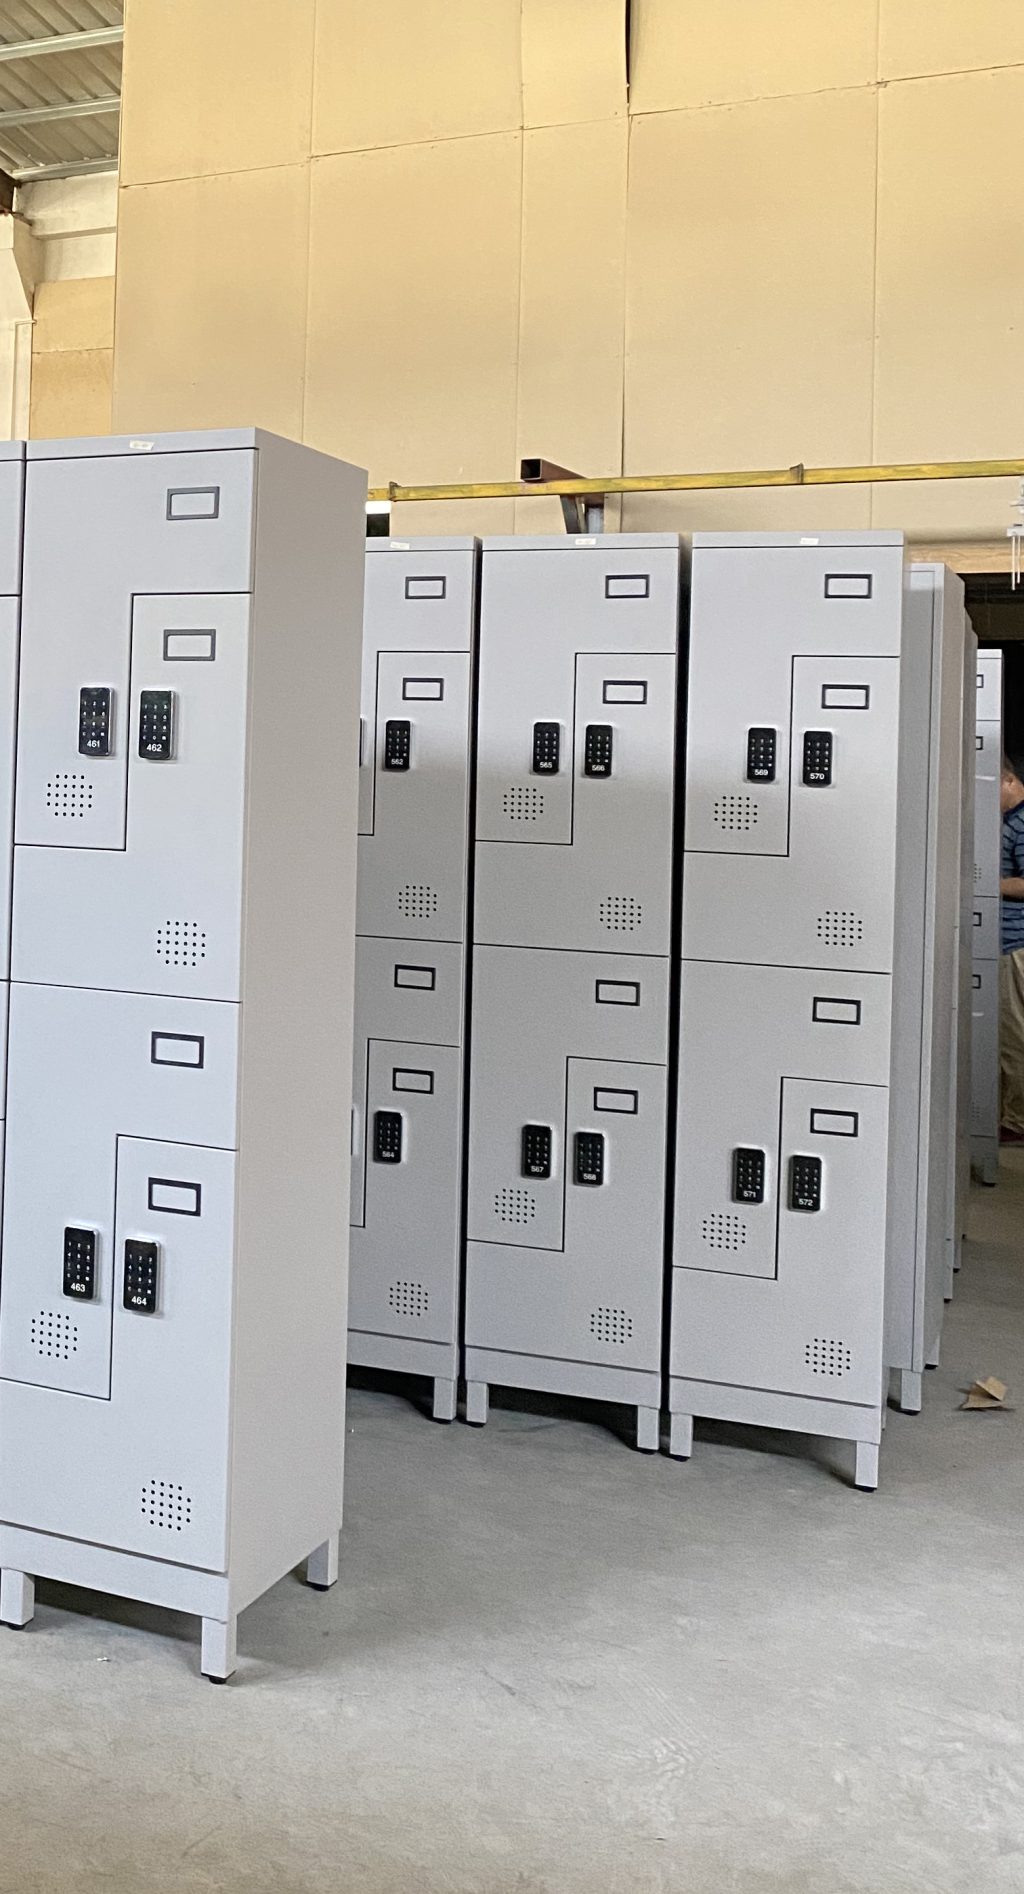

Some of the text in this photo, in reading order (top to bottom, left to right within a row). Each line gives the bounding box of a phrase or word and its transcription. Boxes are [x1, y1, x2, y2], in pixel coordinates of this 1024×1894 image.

[86, 739, 100, 748] 461
[146, 743, 163, 752] 462
[390, 758, 404, 766] 562
[539, 761, 553, 769] 565
[754, 768, 769, 776] 569
[809, 772, 825, 780] 570
[743, 1190, 757, 1198] 571
[798, 1198, 814, 1207] 572
[70, 1282, 86, 1293] 463
[131, 1295, 147, 1306] 464
